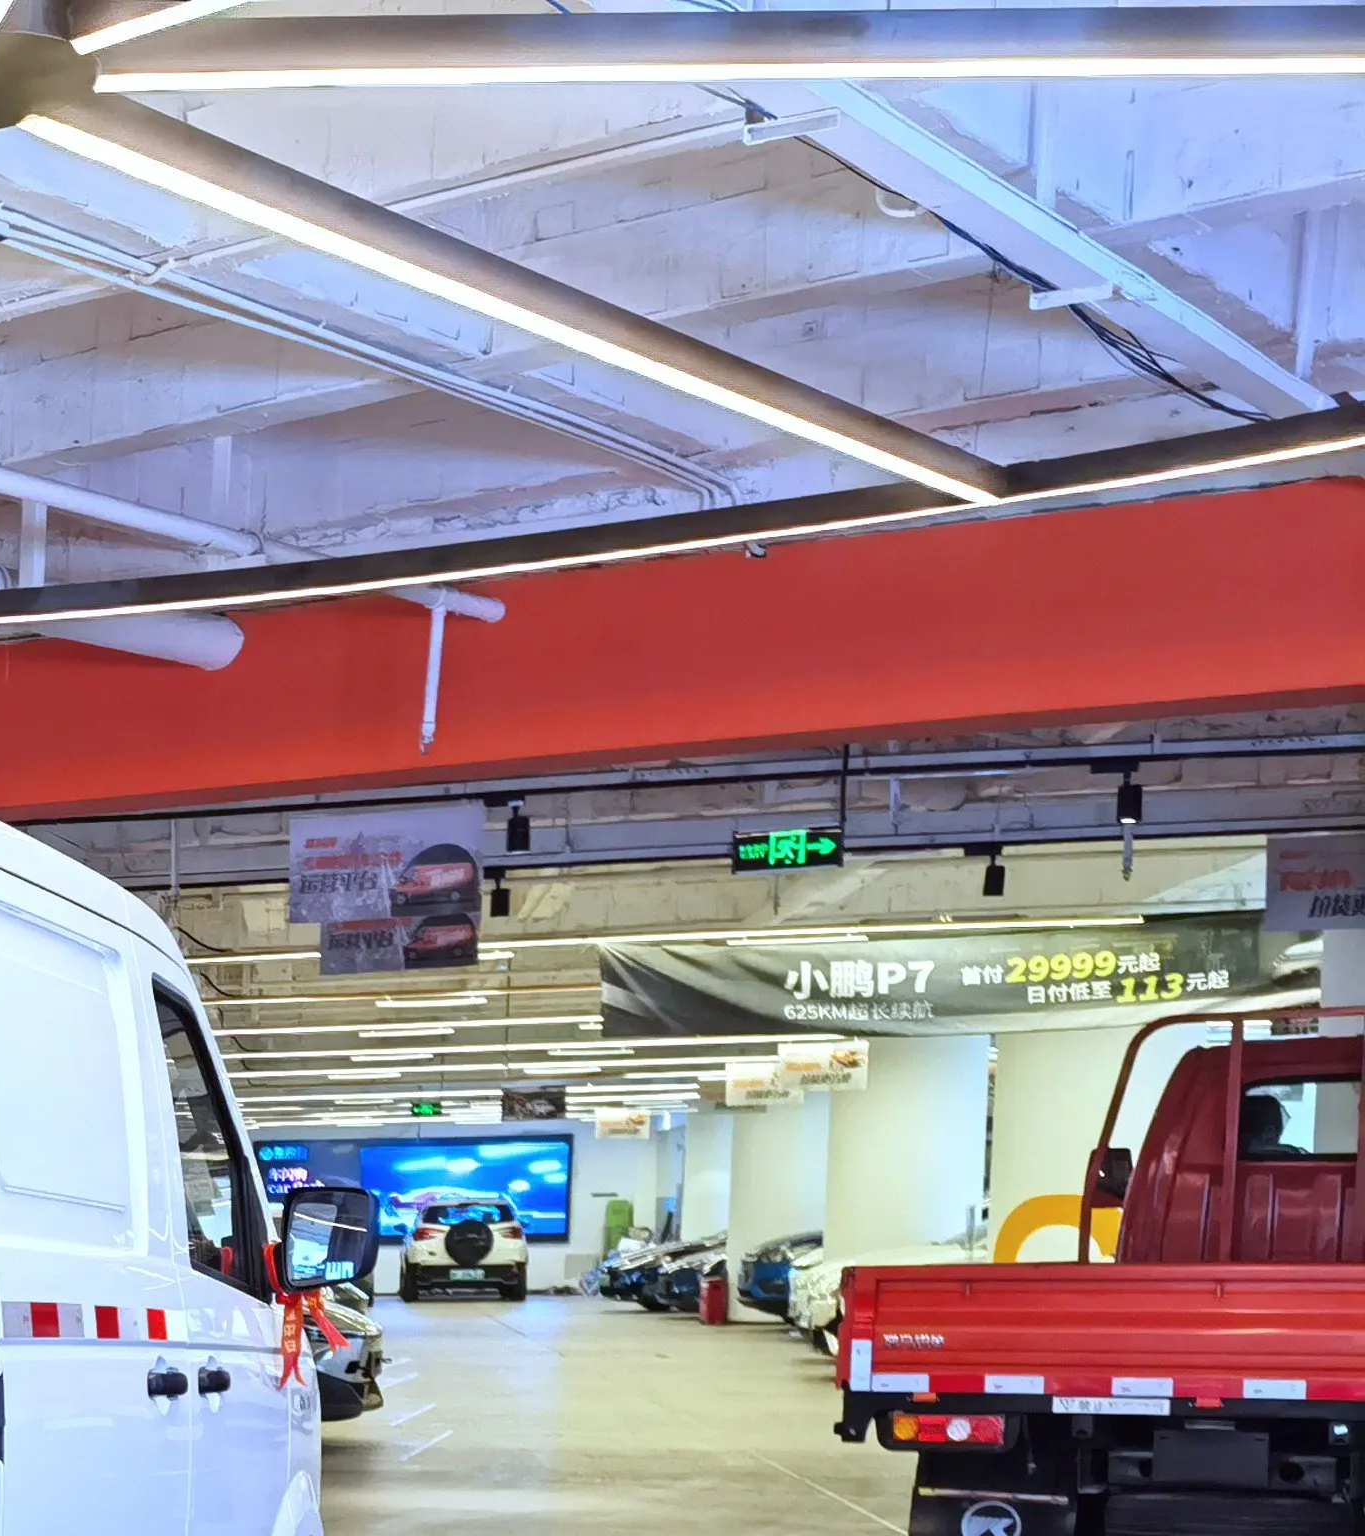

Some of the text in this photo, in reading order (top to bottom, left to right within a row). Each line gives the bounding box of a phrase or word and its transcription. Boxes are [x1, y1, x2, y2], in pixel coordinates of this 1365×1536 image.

[783, 959, 936, 1000] 小鹏P7
[960, 950, 1162, 986] 首付29999元起
[1026, 969, 1231, 1005] 日付低至113元起
[783, 1000, 936, 1022] 625KM超长续航
